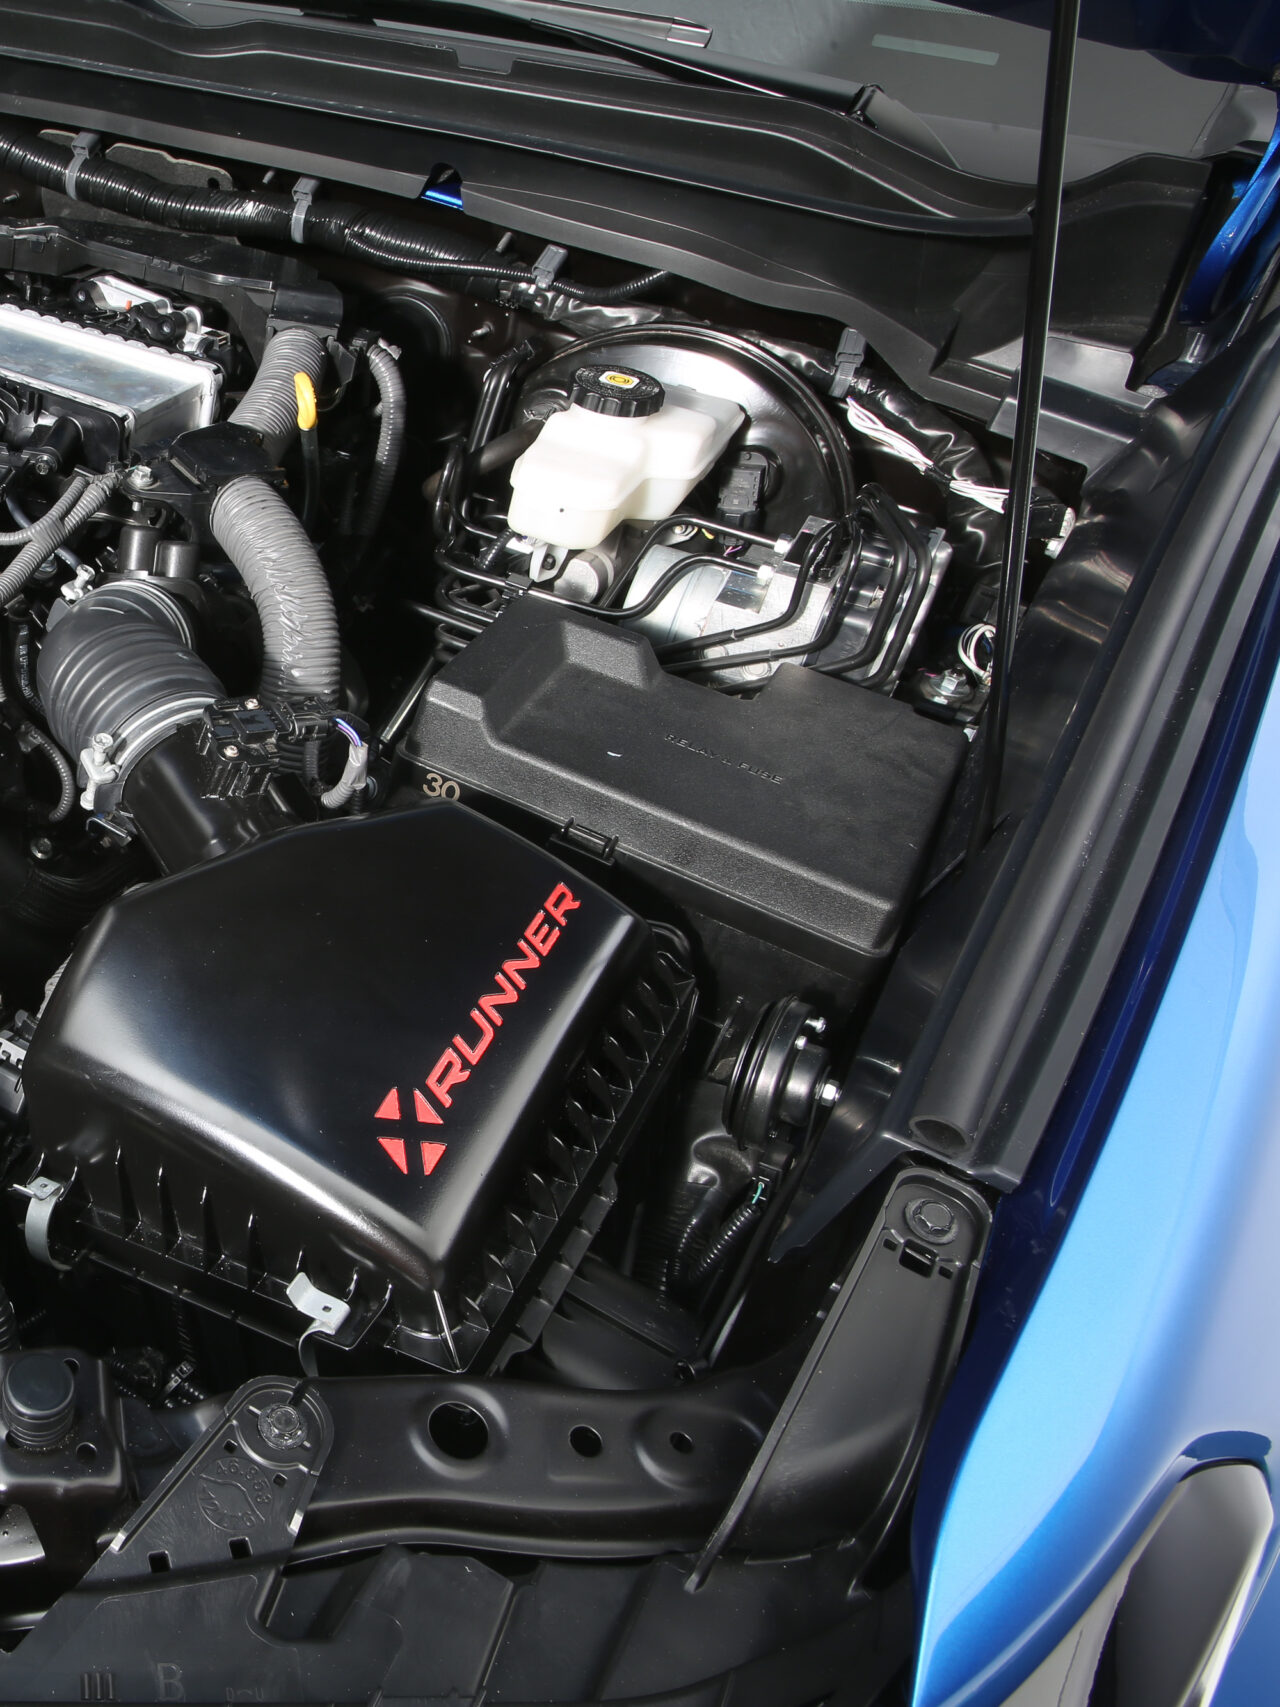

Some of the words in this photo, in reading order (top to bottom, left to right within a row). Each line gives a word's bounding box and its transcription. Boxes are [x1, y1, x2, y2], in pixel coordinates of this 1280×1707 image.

[664, 733, 720, 759] RELAY
[737, 762, 784, 785] FUSE
[422, 771, 461, 801] 30
